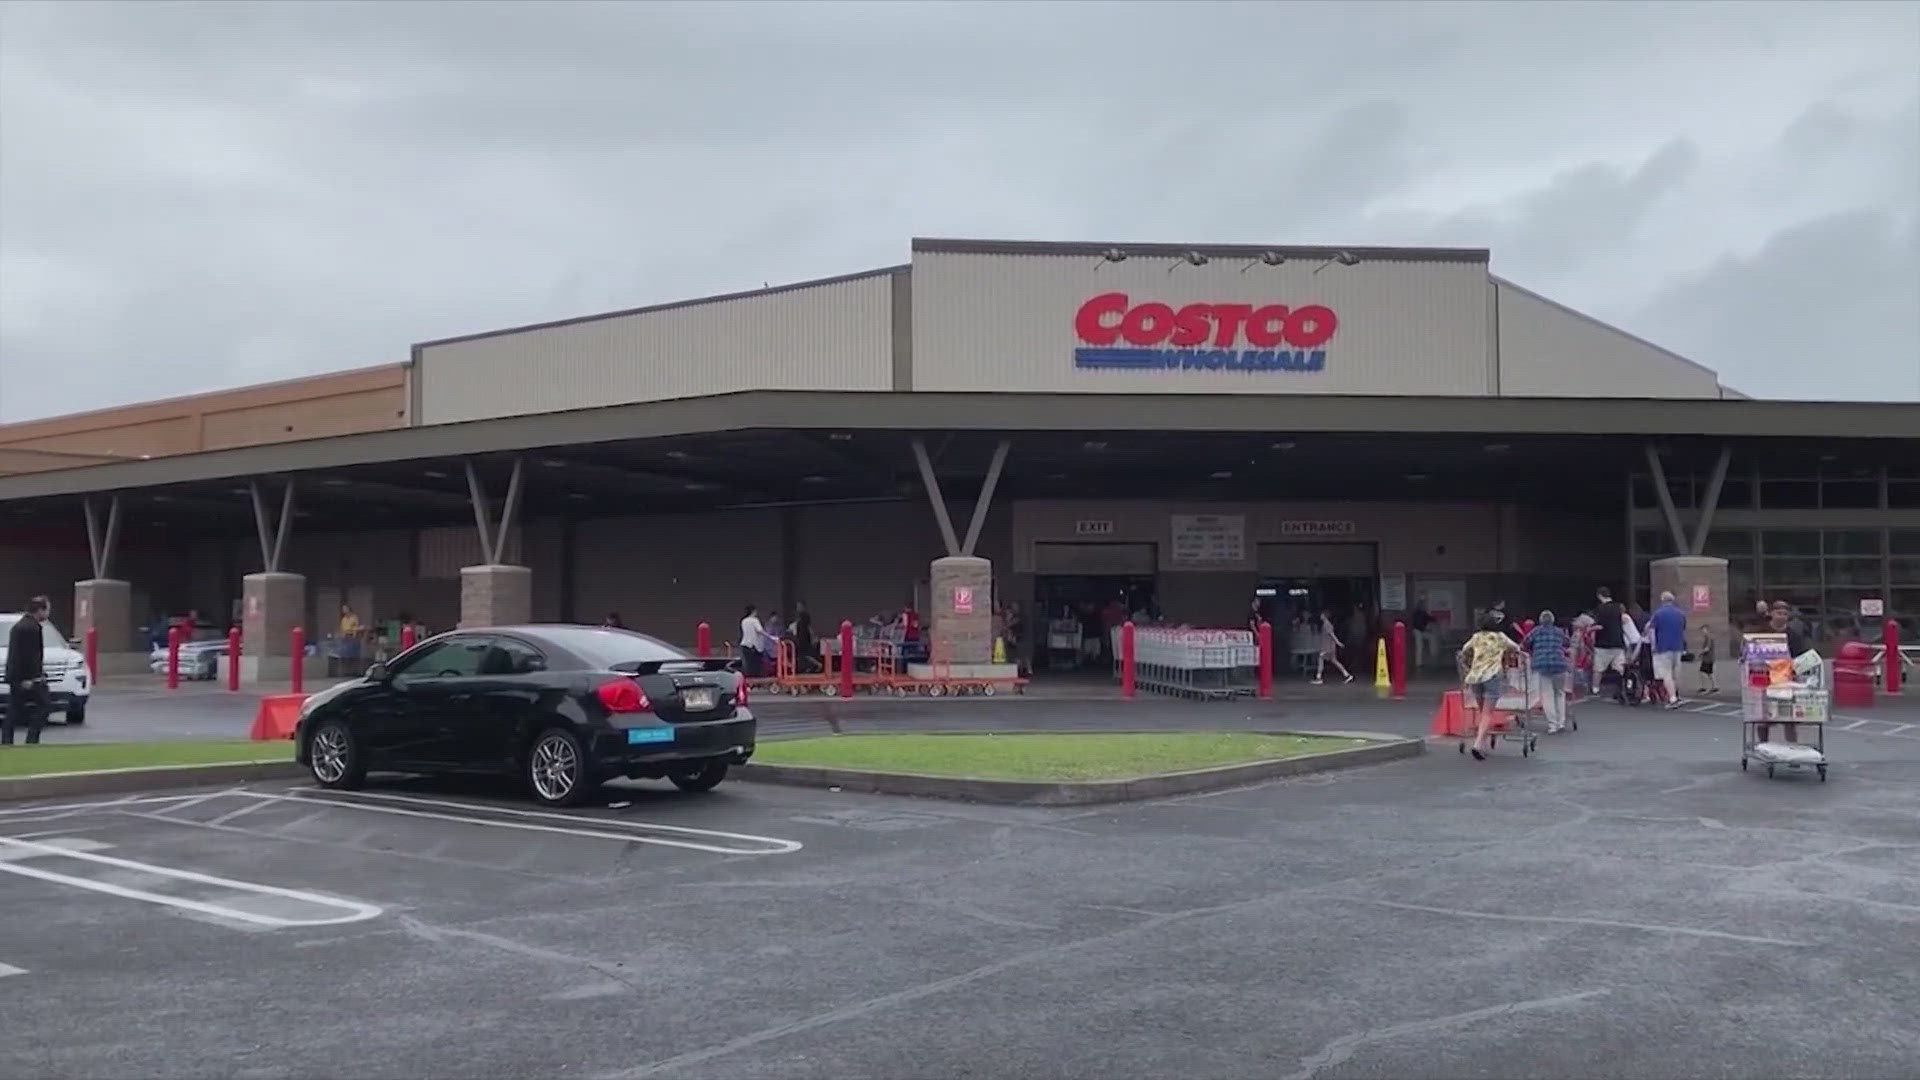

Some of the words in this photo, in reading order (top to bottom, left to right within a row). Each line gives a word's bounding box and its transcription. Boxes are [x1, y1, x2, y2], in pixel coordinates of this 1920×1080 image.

[1075, 292, 1337, 348] COSTCO
[1160, 350, 1327, 371] WHOLESALE
[1080, 522, 1110, 532] EXIT
[1284, 522, 1352, 533] ENTRANCE
